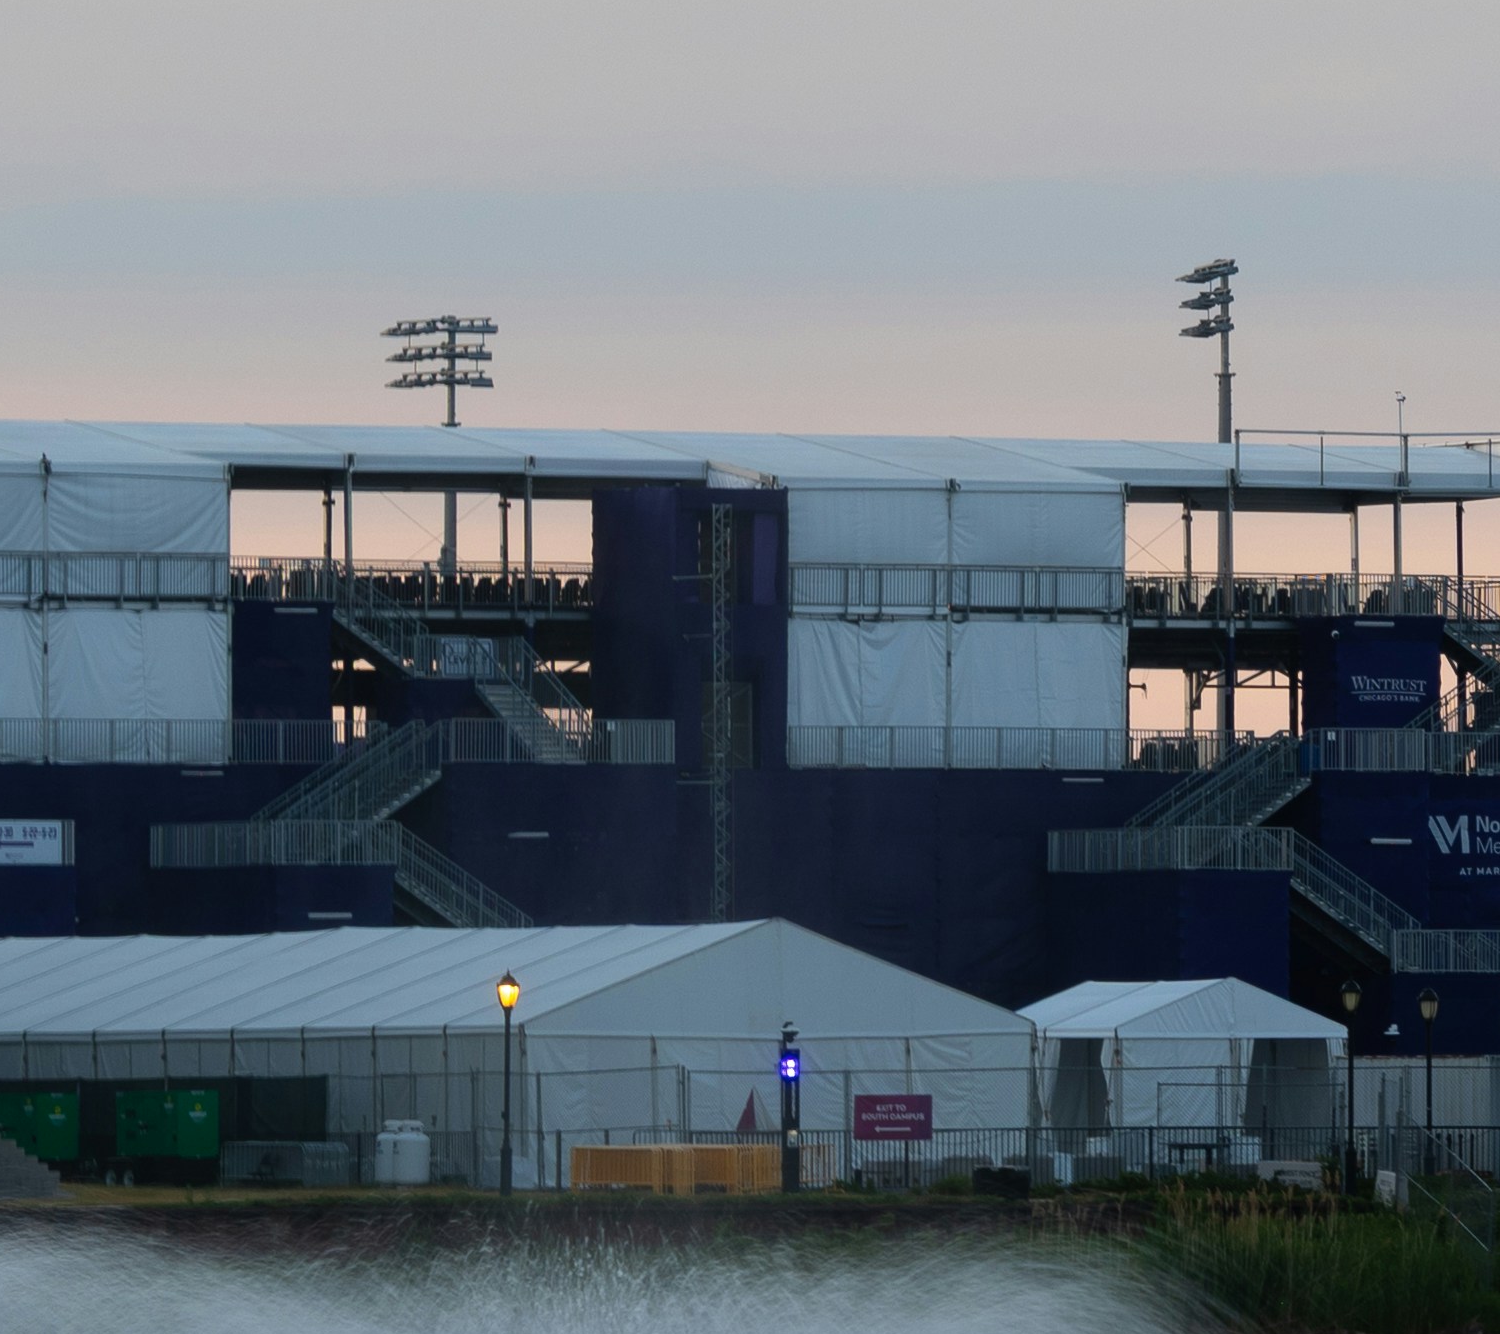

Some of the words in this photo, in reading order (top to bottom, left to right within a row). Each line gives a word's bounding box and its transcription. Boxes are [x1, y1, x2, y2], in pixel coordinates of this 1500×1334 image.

[1351, 676, 1427, 692] WINTRUST
[1399, 695, 1420, 703] BANK
[1459, 866, 1472, 875] AT
